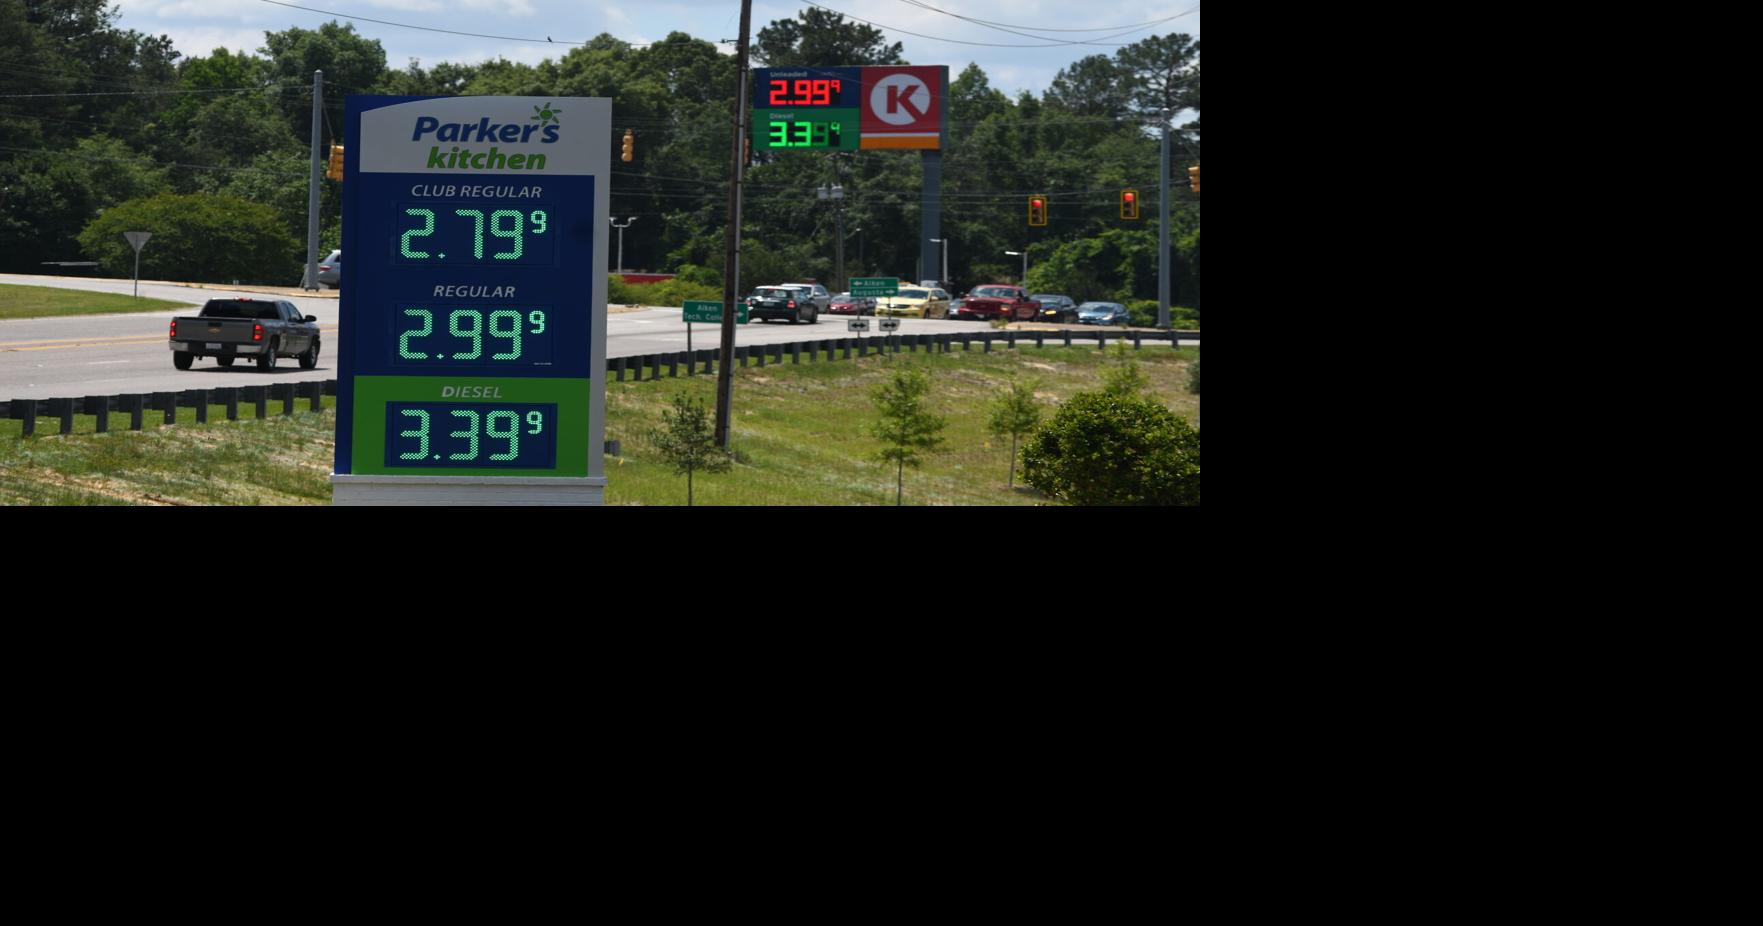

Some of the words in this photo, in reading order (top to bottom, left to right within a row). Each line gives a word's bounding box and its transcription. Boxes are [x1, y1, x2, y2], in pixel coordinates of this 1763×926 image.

[412, 116, 561, 144] Parker's
[426, 147, 547, 170] kitchen
[411, 184, 456, 197] CLUB
[459, 185, 543, 198] REGULAR
[433, 285, 516, 298] REGULAR
[697, 304, 718, 312] Aiken
[441, 385, 503, 399] DIESEL
